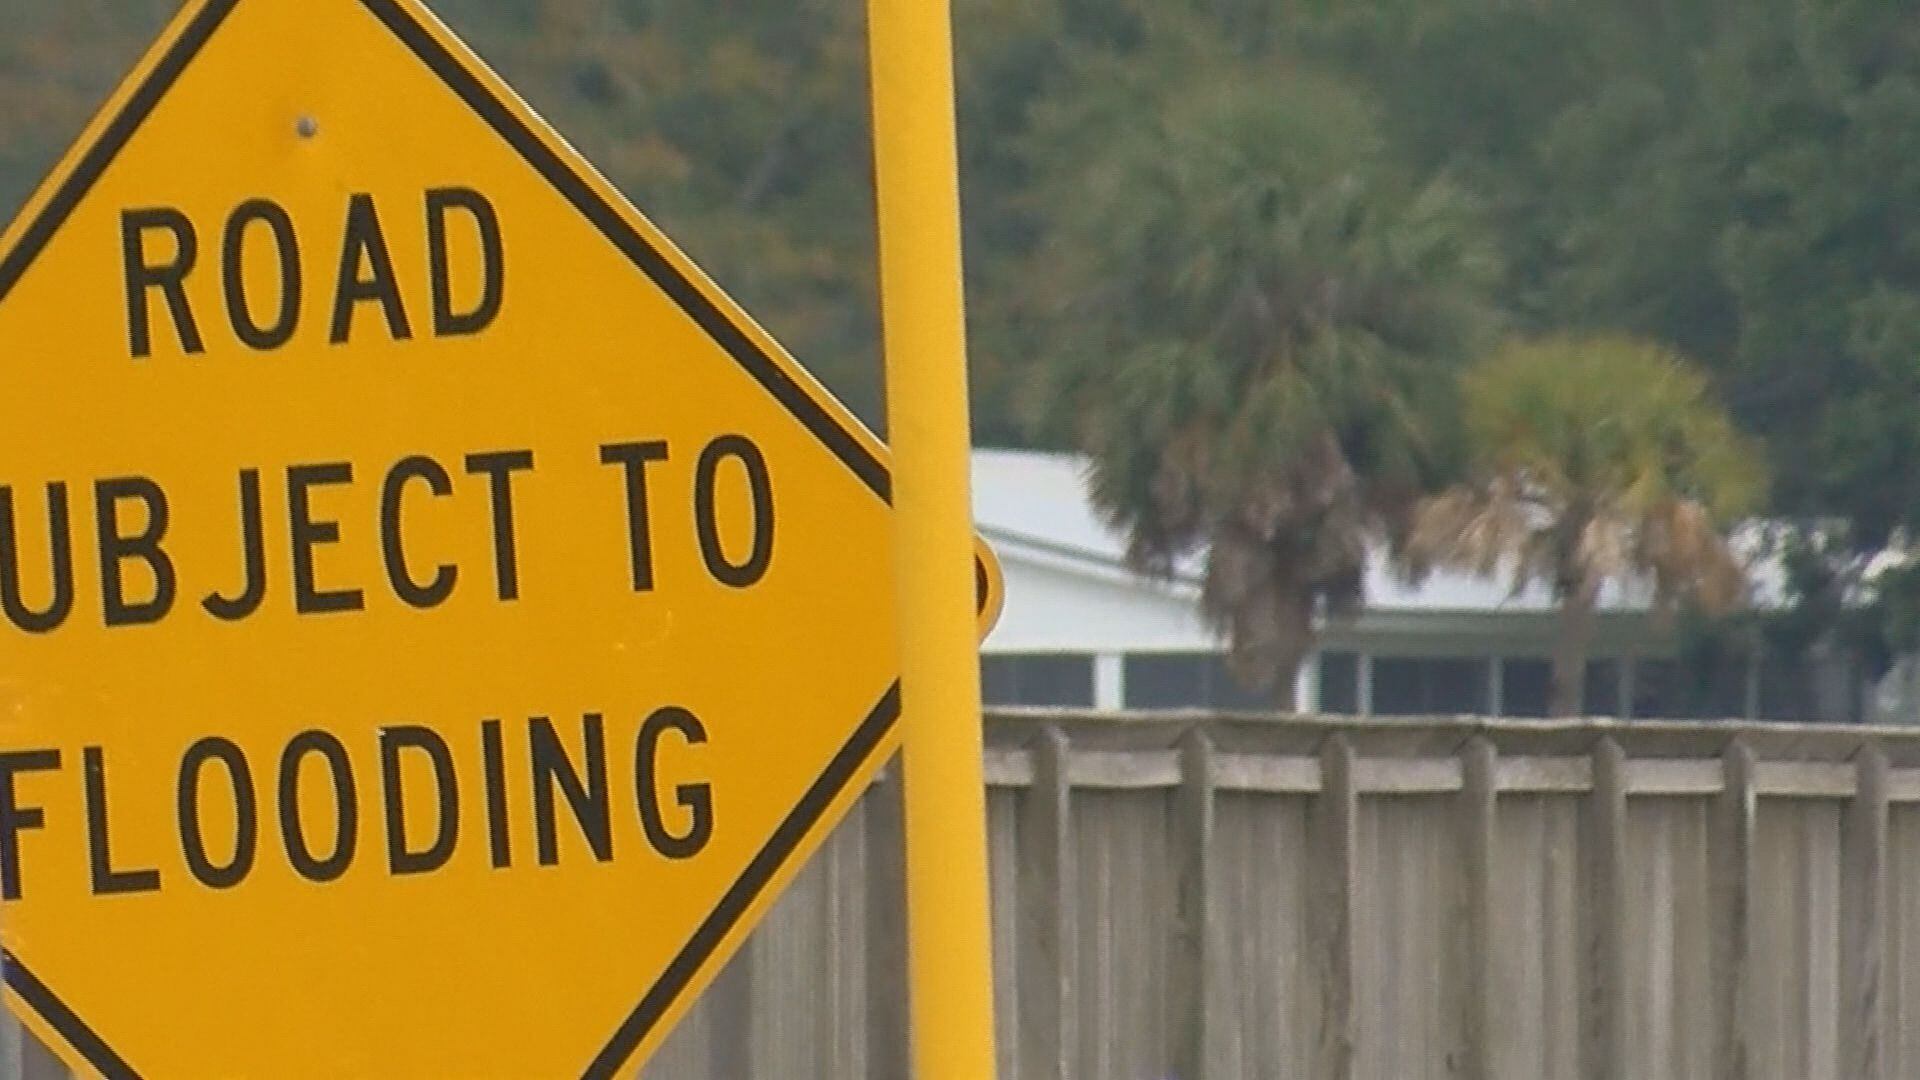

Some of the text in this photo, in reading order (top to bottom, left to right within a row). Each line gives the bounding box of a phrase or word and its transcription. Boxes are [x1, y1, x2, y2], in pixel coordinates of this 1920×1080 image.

[120, 186, 504, 358] ROAD
[0, 434, 775, 634] UBJECT TO
[0, 706, 713, 901] FLOODING
